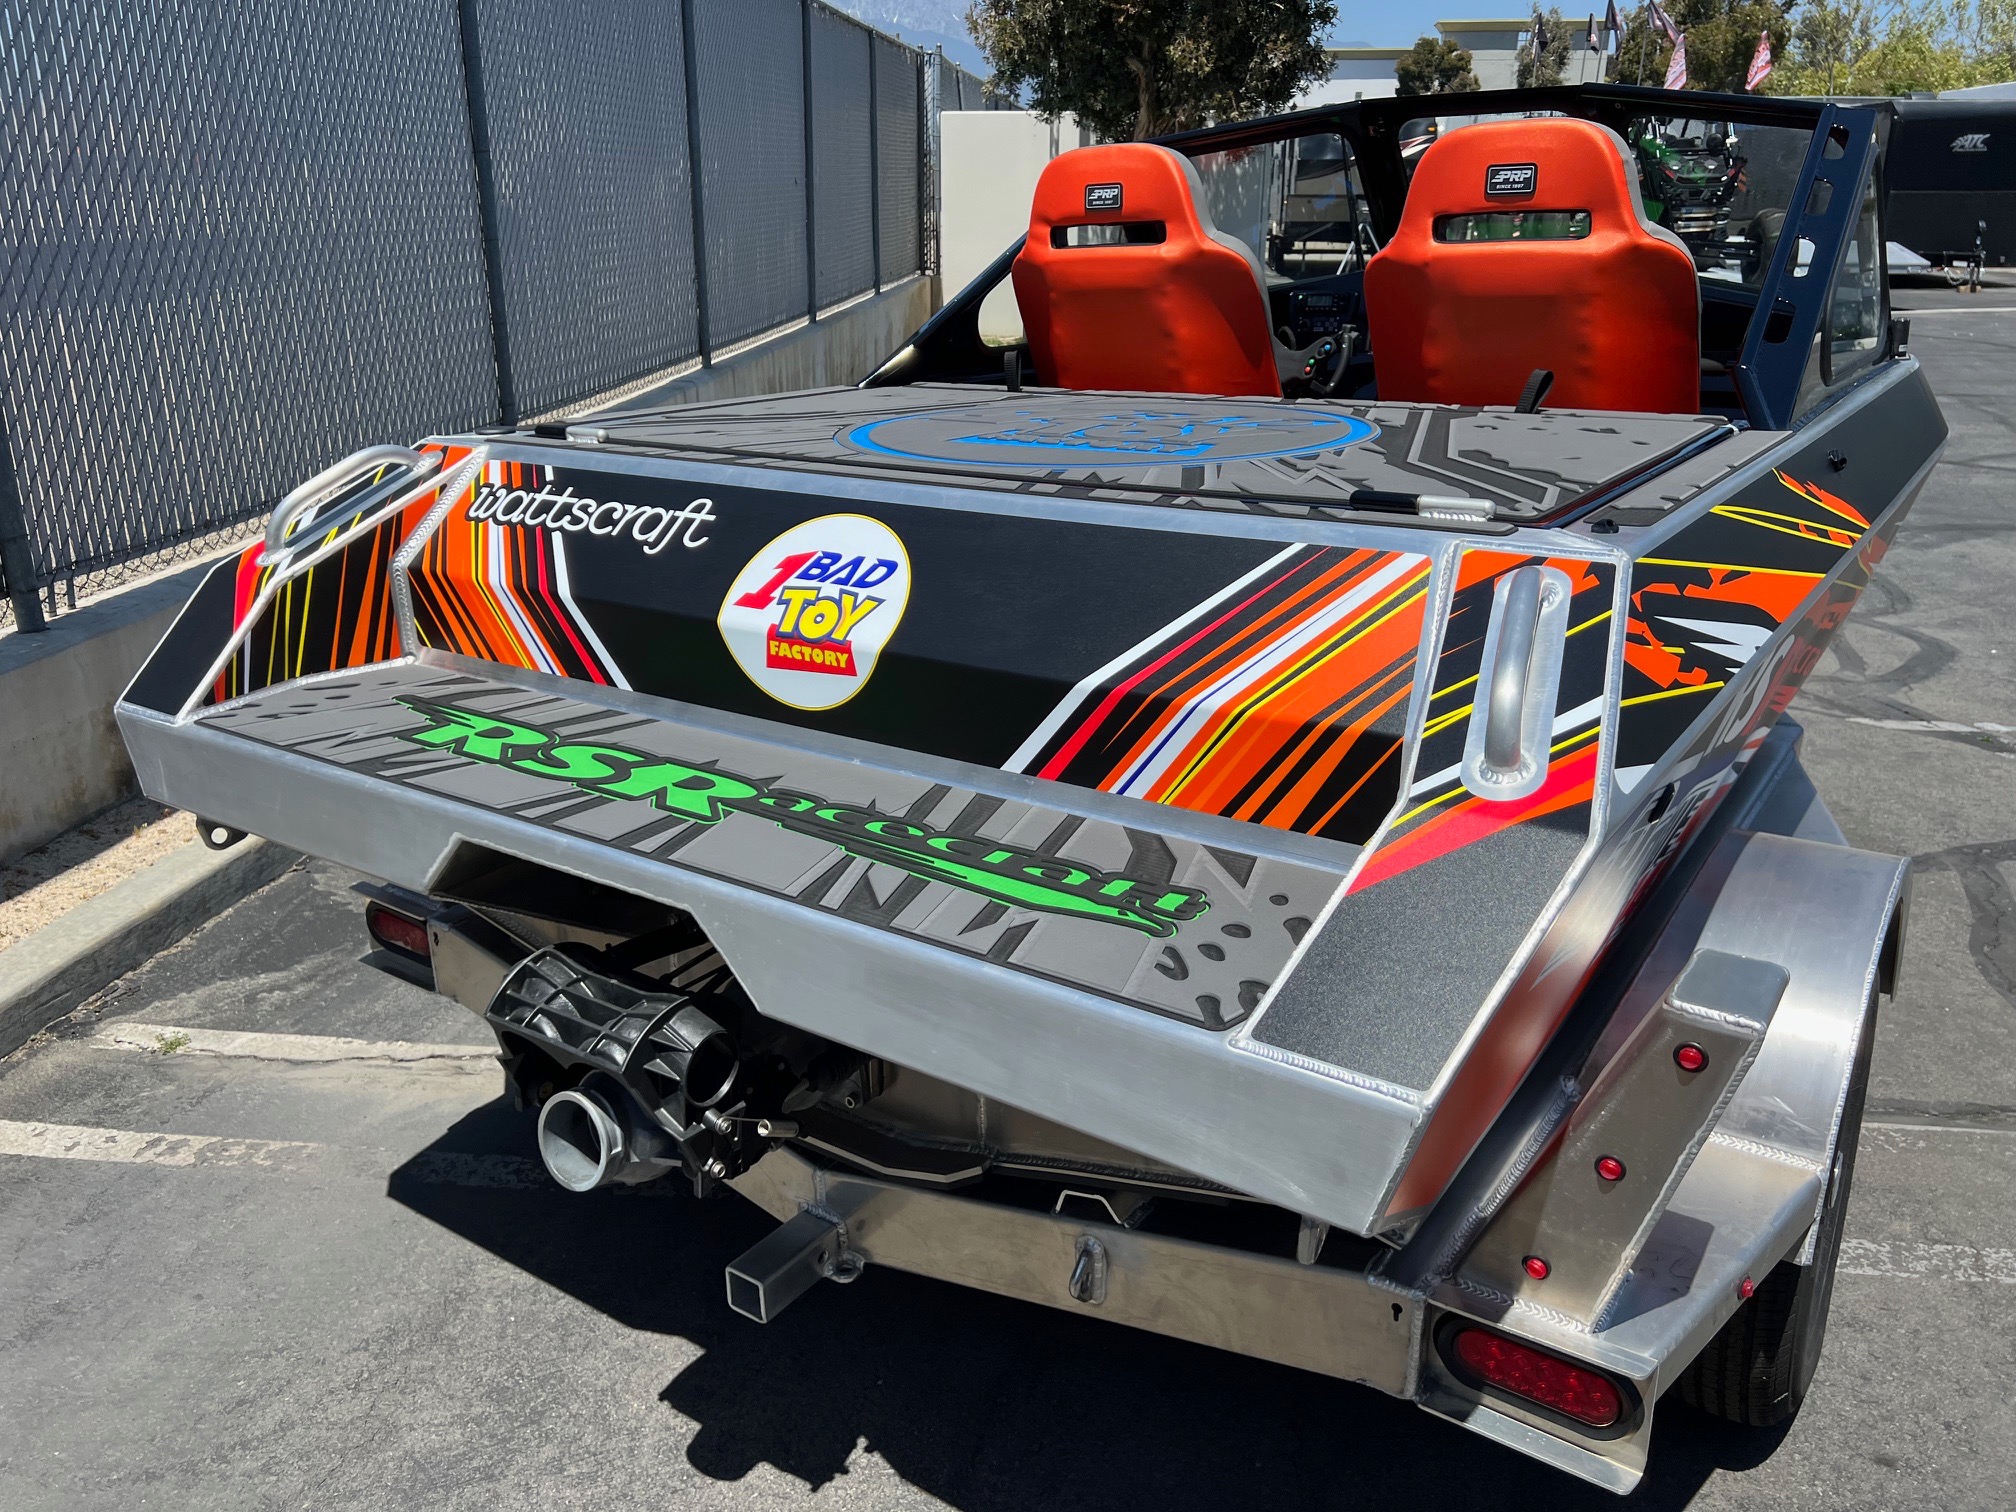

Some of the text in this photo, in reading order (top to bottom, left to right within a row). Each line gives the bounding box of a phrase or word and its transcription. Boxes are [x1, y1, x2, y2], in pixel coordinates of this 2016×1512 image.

[1088, 188, 1118, 199] PRP
[1491, 170, 1532, 183] PRP
[468, 484, 717, 555] wattscraft
[733, 550, 899, 610] 1 BAD
[776, 585, 888, 646] TOY
[769, 640, 850, 669] FACTORY
